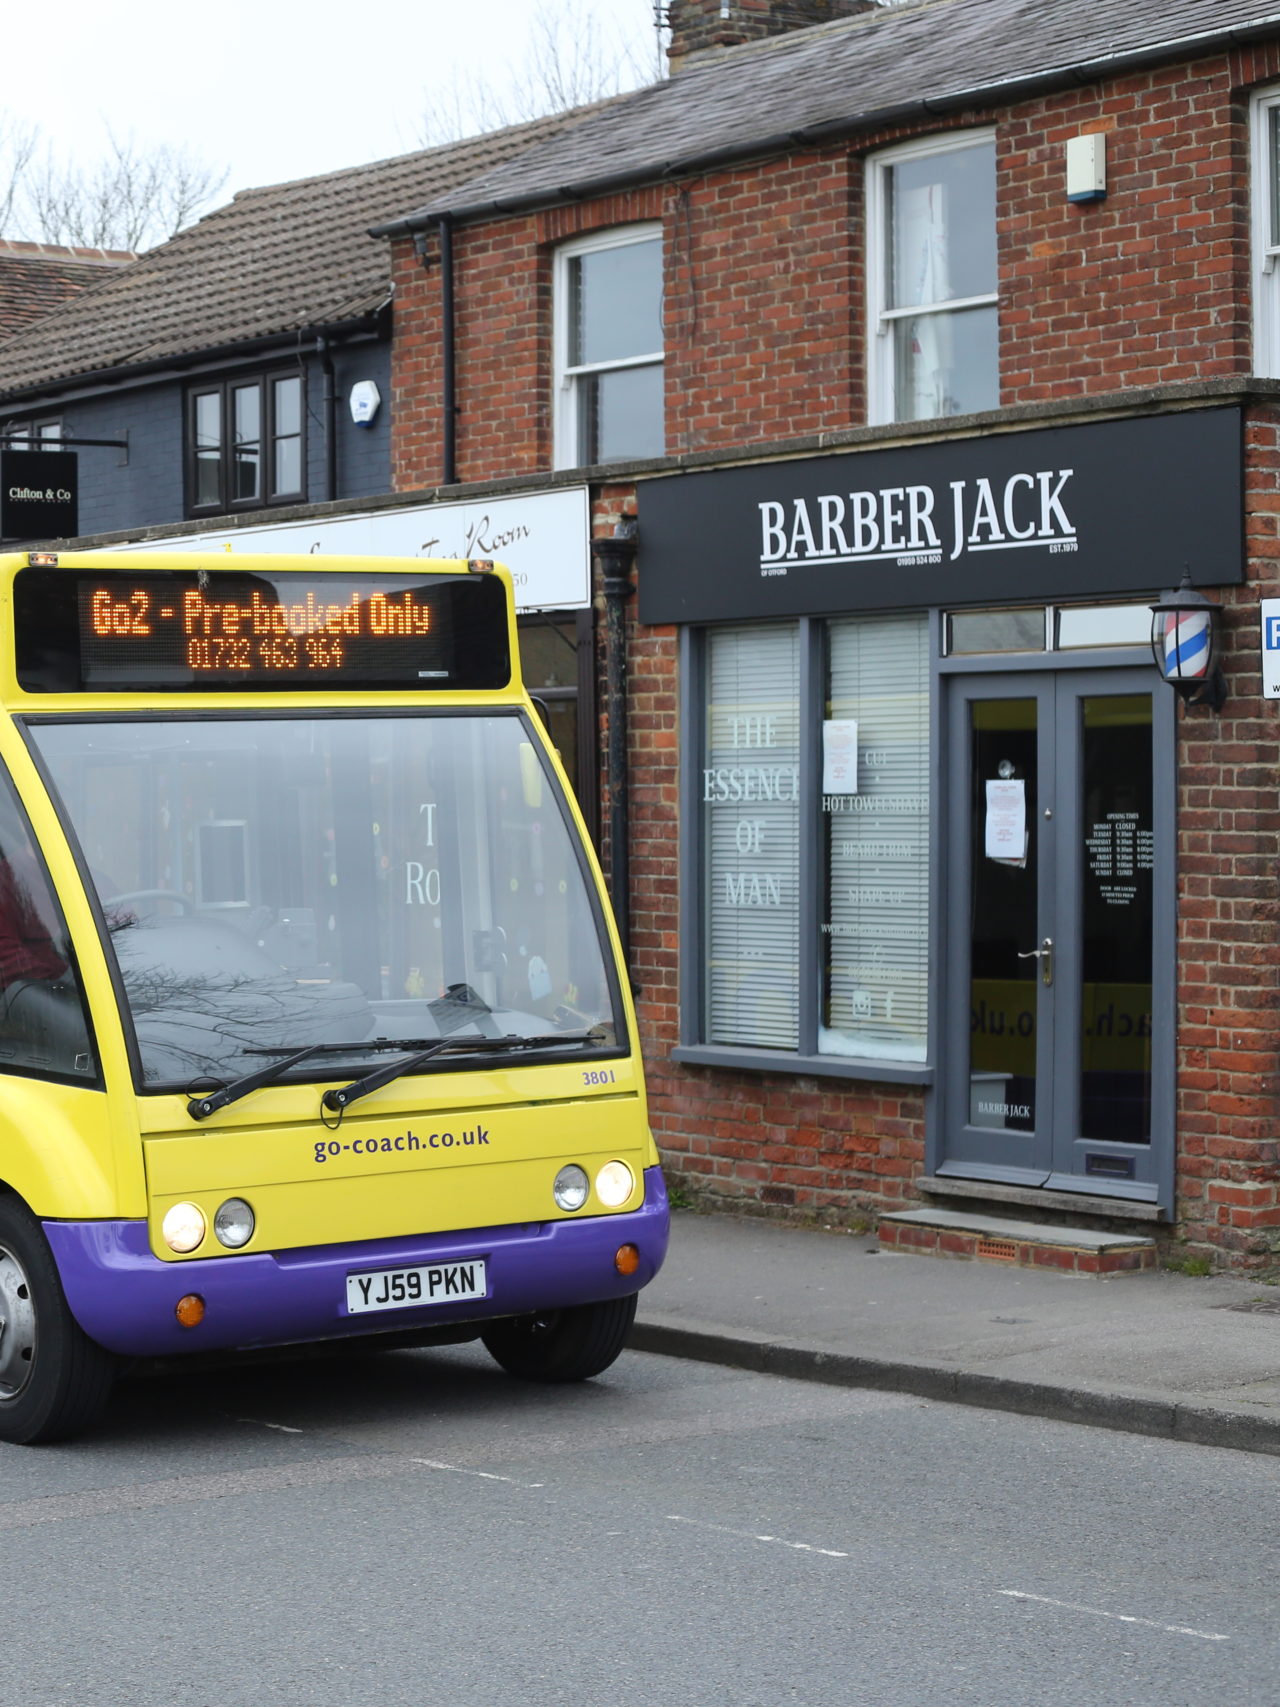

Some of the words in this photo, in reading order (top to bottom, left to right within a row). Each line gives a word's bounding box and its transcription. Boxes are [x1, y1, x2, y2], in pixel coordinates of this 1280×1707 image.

[8, 487, 44, 499] Clifton
[45, 488, 54, 499] &
[56, 489, 71, 500] Co
[758, 484, 942, 561] BARBER
[949, 468, 1077, 560] JACK
[465, 514, 531, 560] Room
[92, 591, 151, 635] Go2
[184, 591, 361, 635] Pre-booked
[370, 592, 431, 635] Only
[188, 638, 251, 669] 01732
[259, 638, 299, 669] 463
[305, 638, 343, 669] 964
[727, 716, 777, 749] THE
[822, 796, 846, 812] HOT
[736, 820, 765, 854] OF
[725, 873, 781, 906] MAN
[582, 1069, 616, 1086] 3801
[978, 1101, 1009, 1115] BARBER
[1009, 1103, 1031, 1119] JACK
[313, 1125, 491, 1163] go-coach.co.uk
[357, 1271, 421, 1306] YJ59
[428, 1264, 476, 1297] PKN
